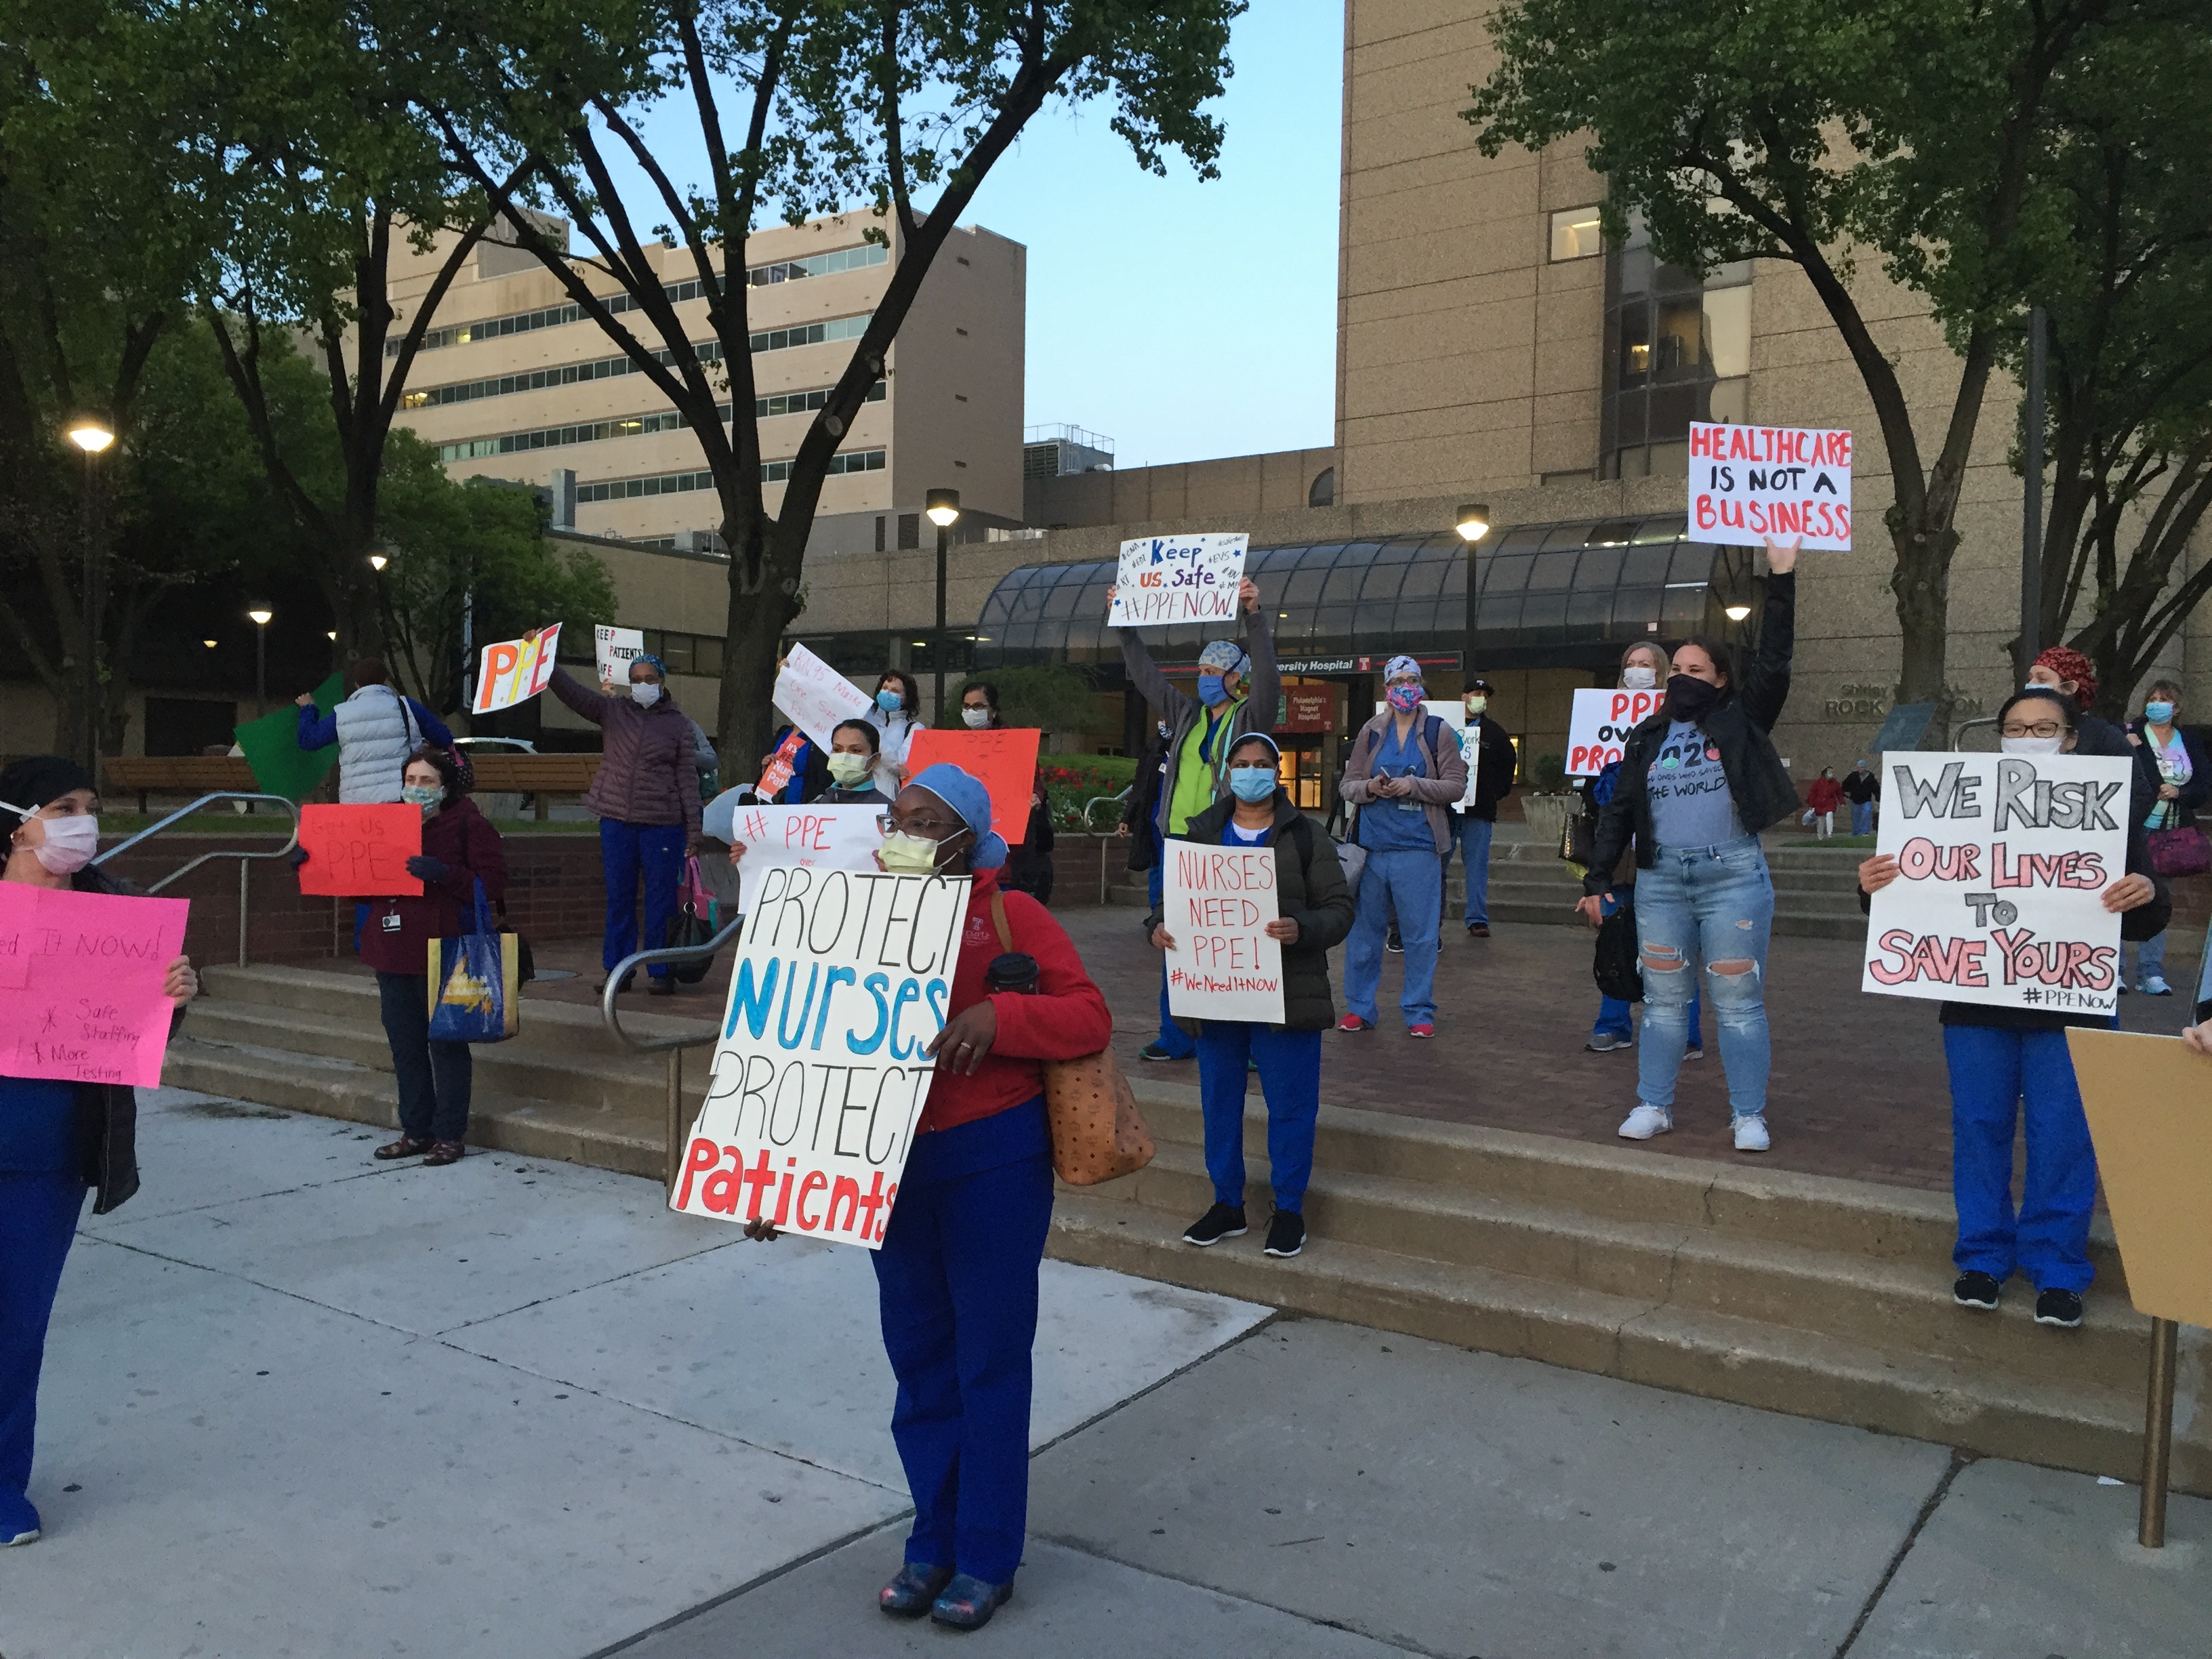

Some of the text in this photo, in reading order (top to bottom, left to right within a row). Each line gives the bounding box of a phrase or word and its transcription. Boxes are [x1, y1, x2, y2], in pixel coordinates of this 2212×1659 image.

[1691, 427, 1851, 468] HEALTHCARE
[1711, 465, 1837, 495] IS NOT A
[1696, 494, 1851, 541] BUSINESS
[1150, 539, 1202, 568] Keep
[1172, 565, 1215, 589] Safe
[1120, 590, 1235, 621] #PPENOW
[596, 628, 616, 641] KEEP
[480, 624, 560, 710] PPE
[1309, 659, 1353, 672] Hospital
[1825, 700, 1884, 715] ROCK
[1571, 745, 1622, 772] PRO
[1674, 777, 1726, 797] WORLD
[1893, 758, 2123, 832] WE RISK
[785, 815, 836, 850] PPE
[328, 840, 396, 881] PPE
[1179, 851, 1274, 891] NURSES
[1900, 837, 2107, 890] OUR LIVES
[750, 867, 973, 975] PROTECT
[1189, 897, 1259, 928] NEED
[1965, 893, 2018, 928] TO
[75, 924, 163, 961] NOW!
[1193, 935, 1260, 970] PPE!
[1868, 928, 2117, 991] SAVE YOURS
[726, 957, 948, 1061] Nurses
[51, 1043, 88, 1062] More
[699, 1050, 935, 1165] PROTECT
